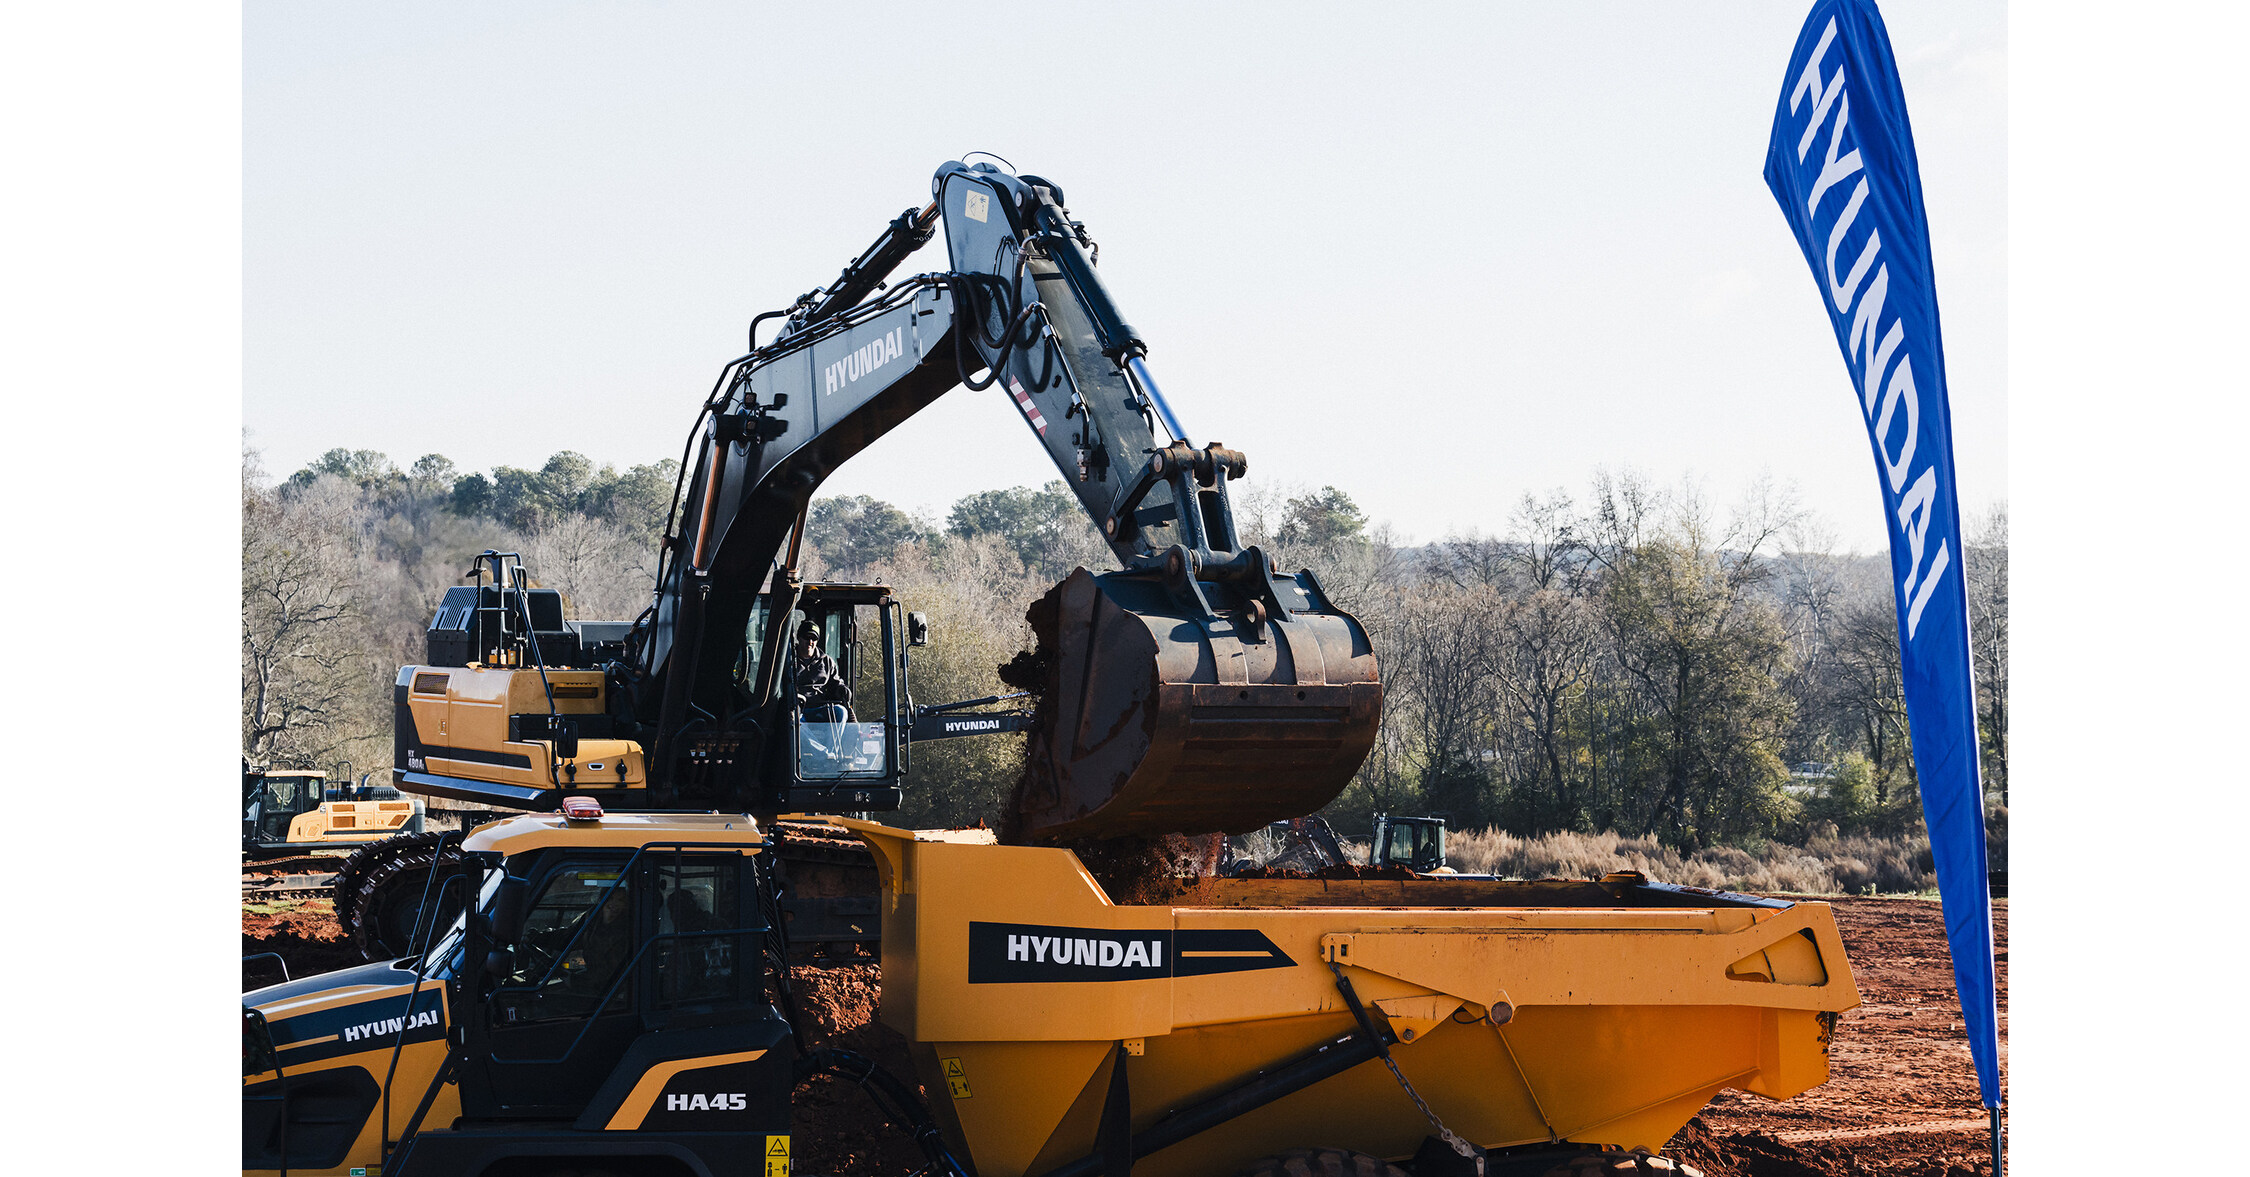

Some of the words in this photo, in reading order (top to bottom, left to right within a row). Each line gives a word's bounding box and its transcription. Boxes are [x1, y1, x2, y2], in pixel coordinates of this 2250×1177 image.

[1791, 15, 1949, 641] HYUNDAI
[825, 326, 903, 396] HYUNDAI
[945, 720, 1000, 731] HYUNDAI
[1008, 935, 1162, 967] HYUNDAI
[667, 1093, 747, 1111] HA45
